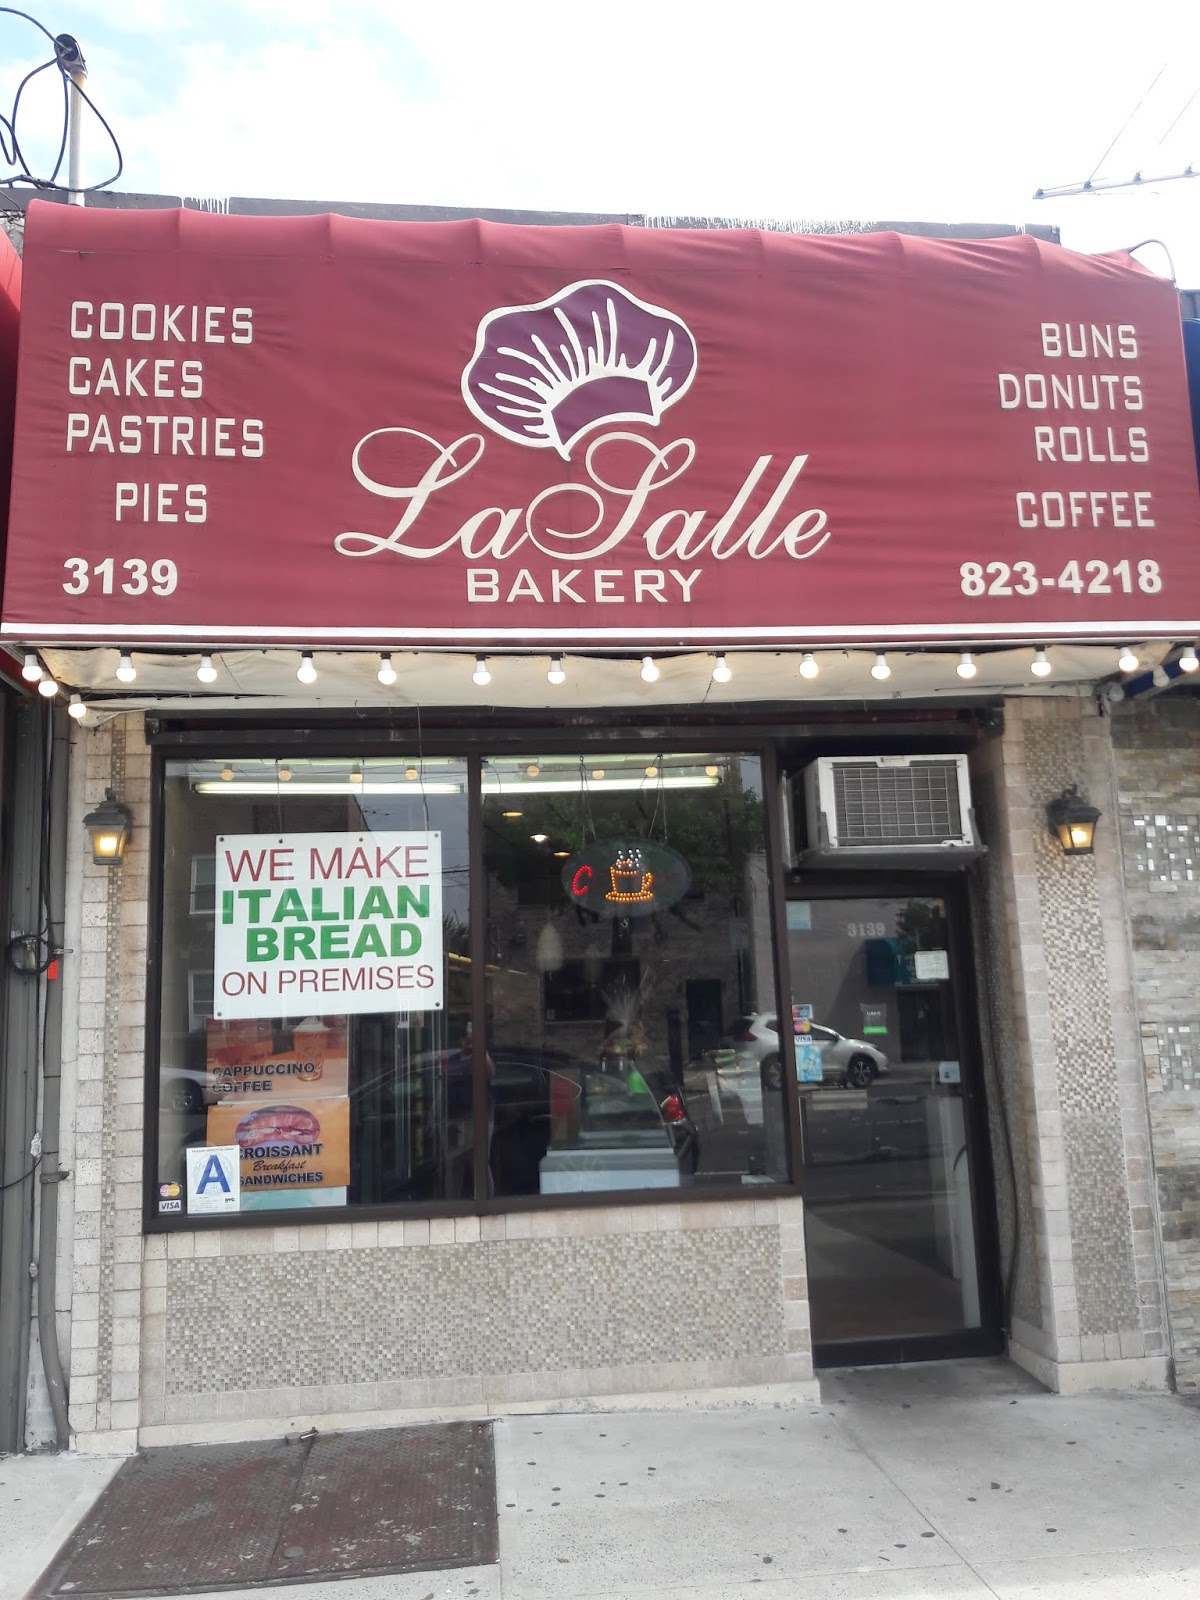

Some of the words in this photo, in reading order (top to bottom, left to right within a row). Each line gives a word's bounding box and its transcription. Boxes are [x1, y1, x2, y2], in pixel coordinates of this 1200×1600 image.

[70, 301, 254, 345] COOKIES
[1041, 322, 1138, 360] BUNS
[68, 357, 203, 398] CAKES
[998, 373, 1143, 411] DONUTS
[66, 414, 264, 458] PASTRIES
[1035, 425, 1149, 463] ROLLS
[115, 482, 207, 523] PIES
[1016, 491, 1155, 528] COFFEE
[62, 557, 178, 596] 3139
[467, 568, 702, 604] BAKERY
[960, 559, 1162, 597] 823-4218
[225, 848, 294, 882] WE
[310, 846, 429, 879] MAKE
[222, 884, 430, 924] ITALIAN
[246, 923, 422, 962] BREAD
[847, 922, 886, 937] 3139
[222, 971, 267, 996] ON
[279, 964, 434, 993] PREMISES
[212, 1062, 315, 1077] CAPPUCCINO
[212, 1080, 272, 1094] COFFEE
[196, 1154, 231, 1194] A
[253, 1159, 307, 1173] Breakfast
[161, 1201, 180, 1210] VISA
